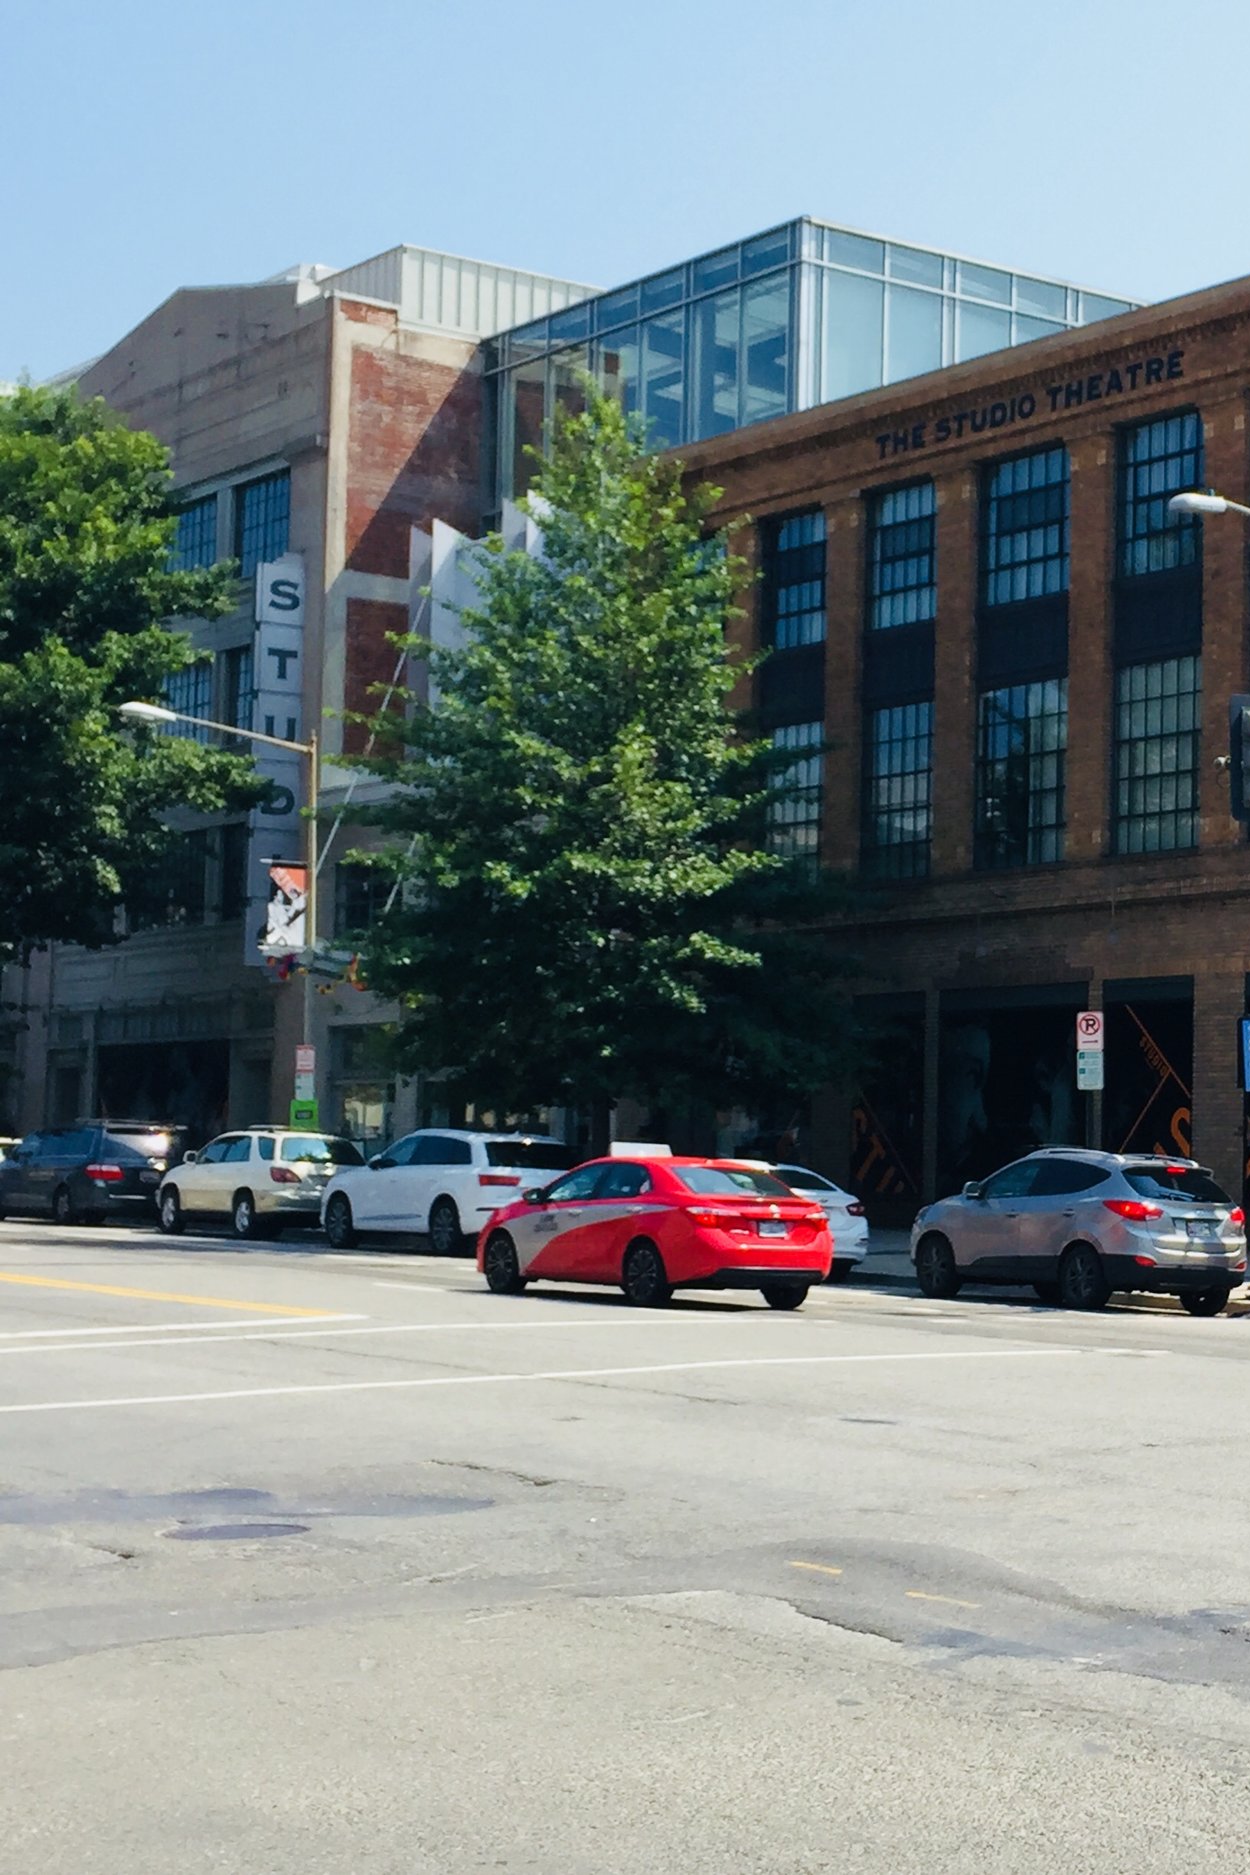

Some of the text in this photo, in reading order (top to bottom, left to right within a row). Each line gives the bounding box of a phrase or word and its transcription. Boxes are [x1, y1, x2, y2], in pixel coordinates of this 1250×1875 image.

[875, 350, 1185, 460] THE STUDIO THEATRE
